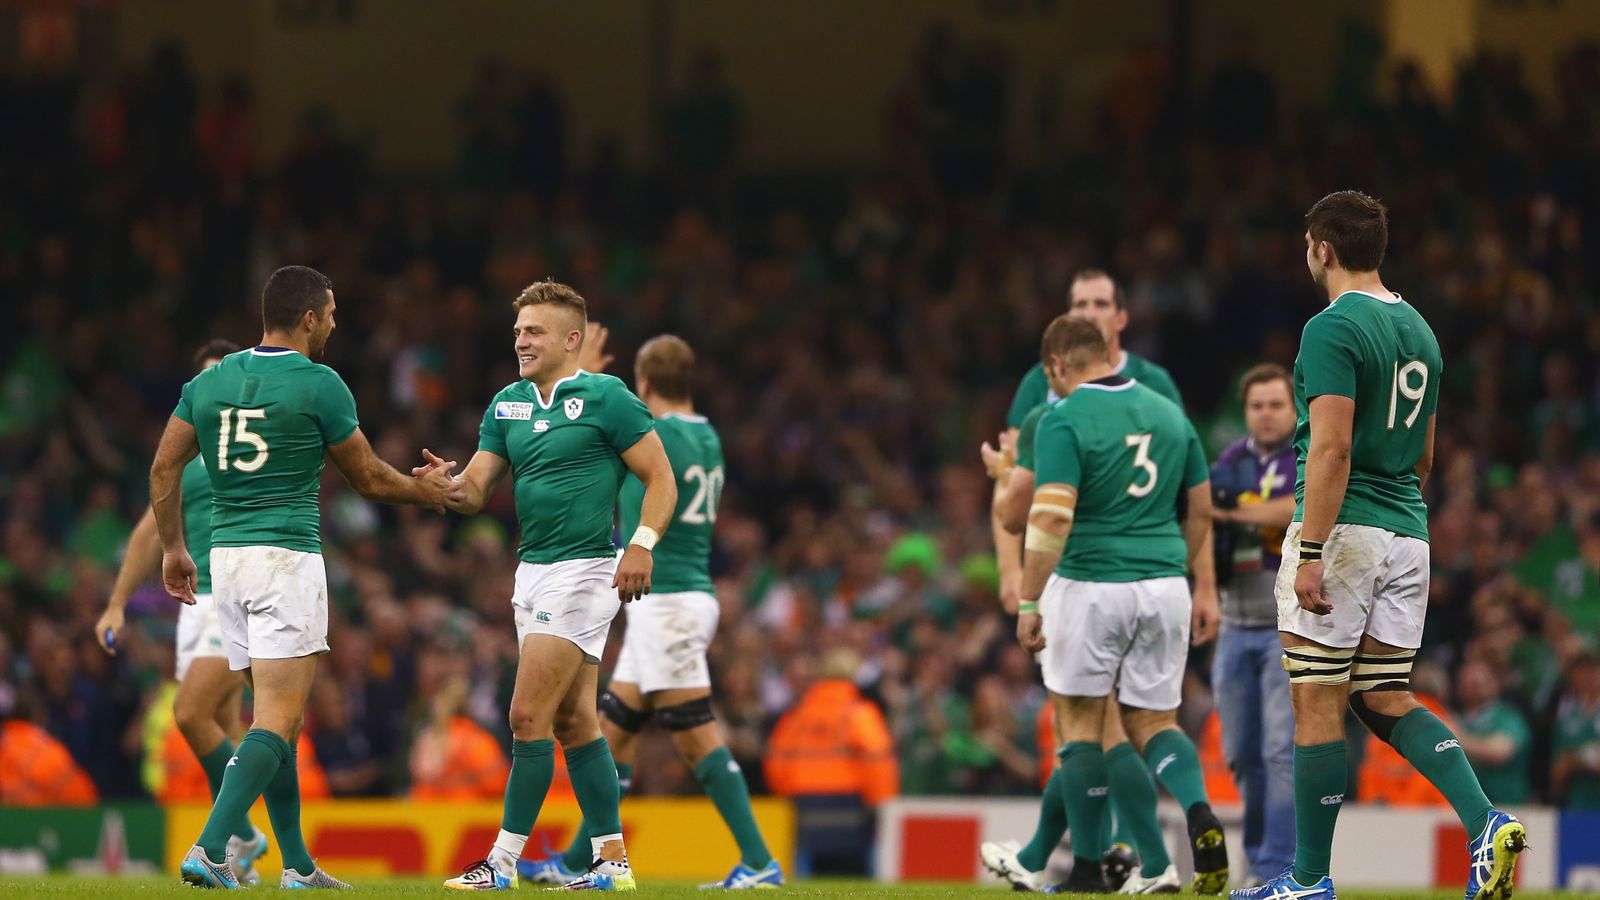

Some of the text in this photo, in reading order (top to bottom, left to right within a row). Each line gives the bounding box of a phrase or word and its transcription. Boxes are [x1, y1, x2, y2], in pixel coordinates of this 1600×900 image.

[1386, 360, 1428, 430] 19
[217, 407, 270, 473] 15
[1125, 432, 1158, 497] 3
[680, 463, 724, 524] 20
